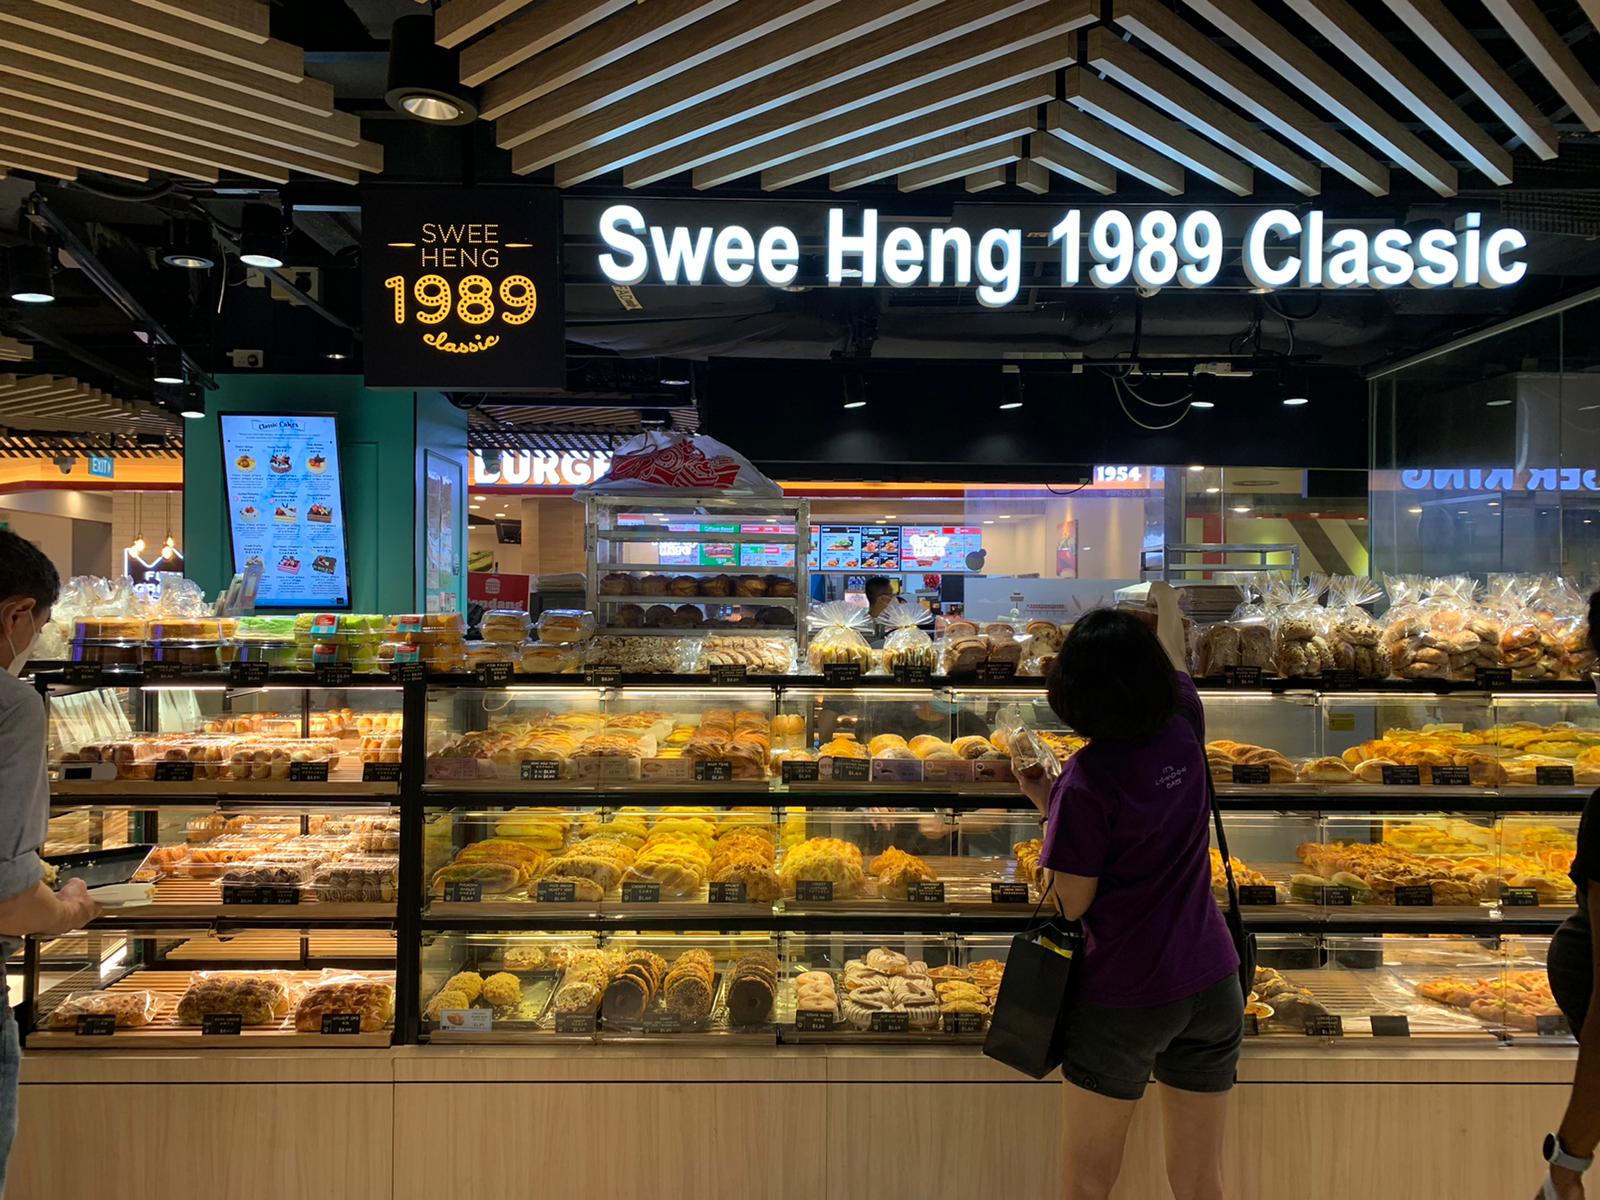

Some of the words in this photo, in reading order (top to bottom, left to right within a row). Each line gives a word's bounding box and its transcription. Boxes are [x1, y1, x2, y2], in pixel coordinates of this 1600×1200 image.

[422, 223, 499, 243] SWEE
[421, 248, 499, 268] HENG
[598, 204, 800, 286] Swee
[828, 207, 1022, 307] Heng
[1048, 208, 1224, 287] 1989
[1242, 208, 1528, 289] Classic
[384, 274, 537, 325] 1989
[92, 457, 107, 474] EXIT
[1097, 465, 1142, 482] 1954
